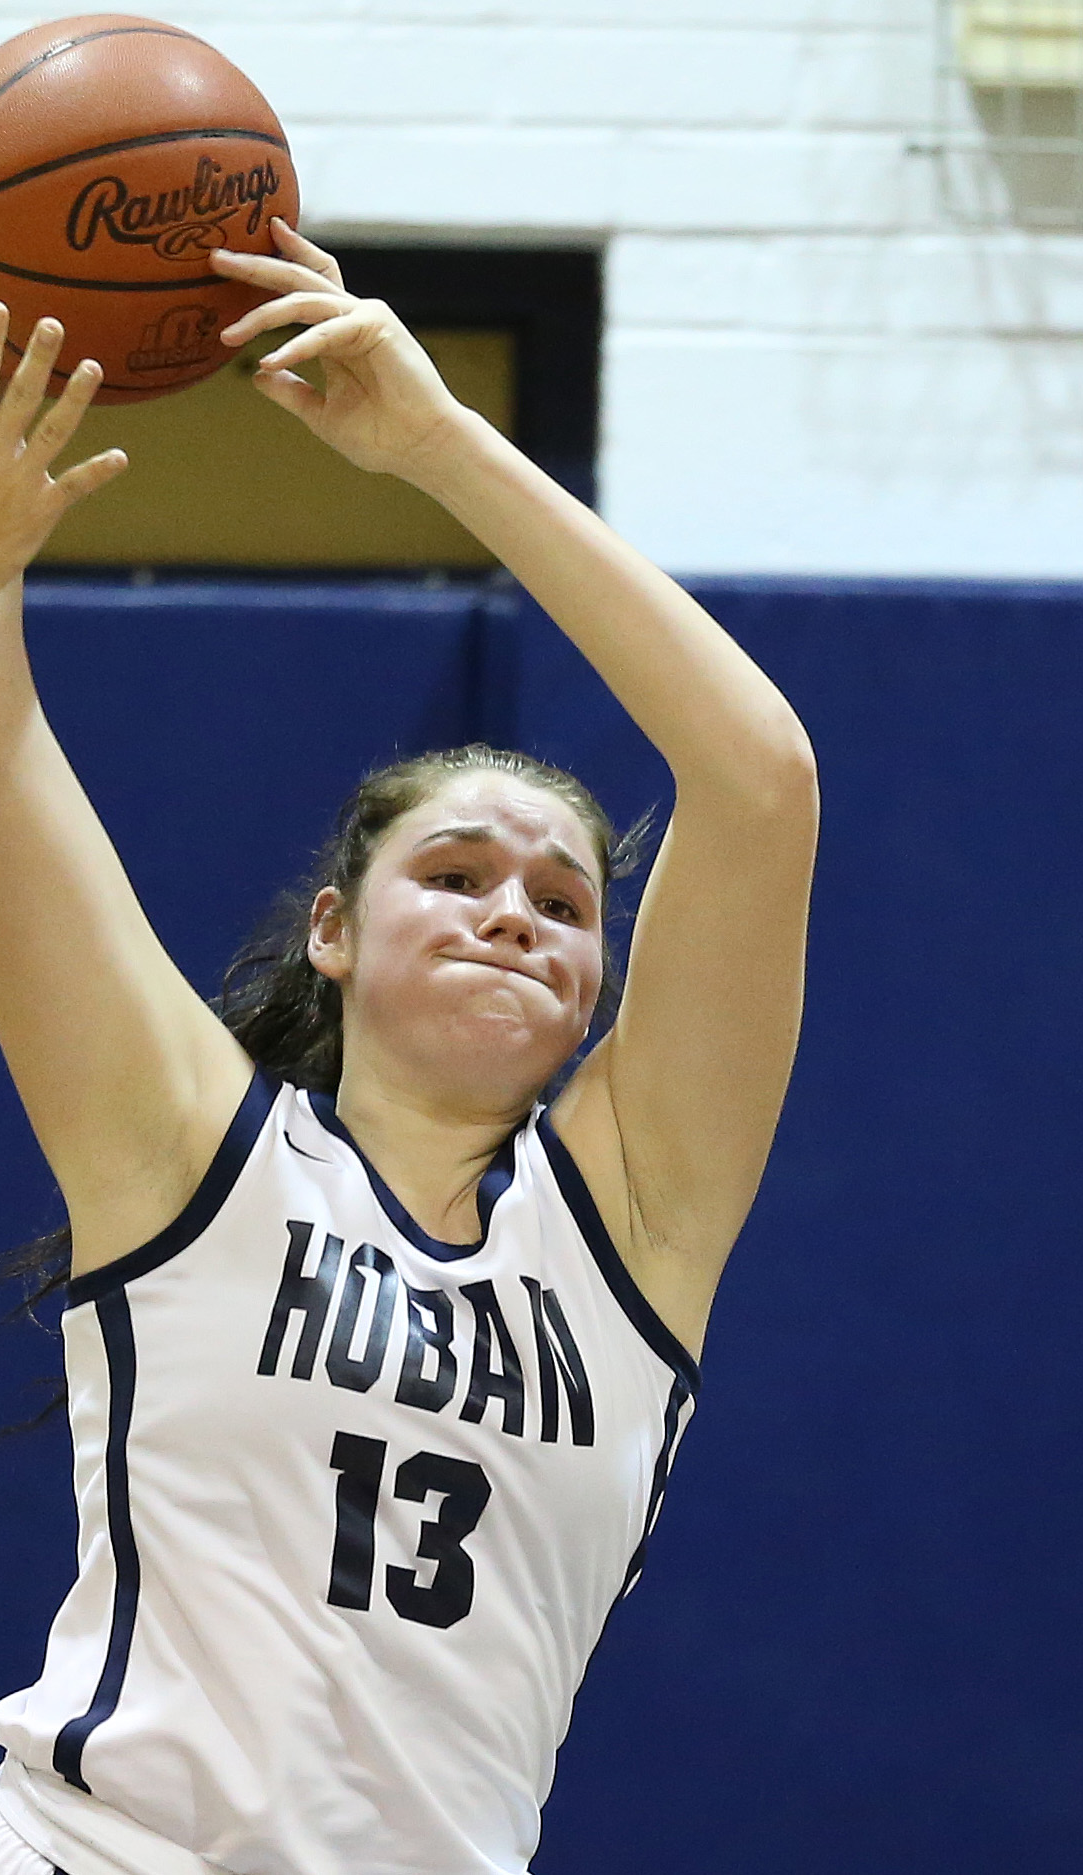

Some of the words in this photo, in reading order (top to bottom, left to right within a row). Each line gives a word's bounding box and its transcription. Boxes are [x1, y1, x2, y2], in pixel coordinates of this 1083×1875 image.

[67, 157, 280, 250] Rawlings
[257, 1220, 595, 1447] HOBAN
[327, 1430, 492, 1630] 13
